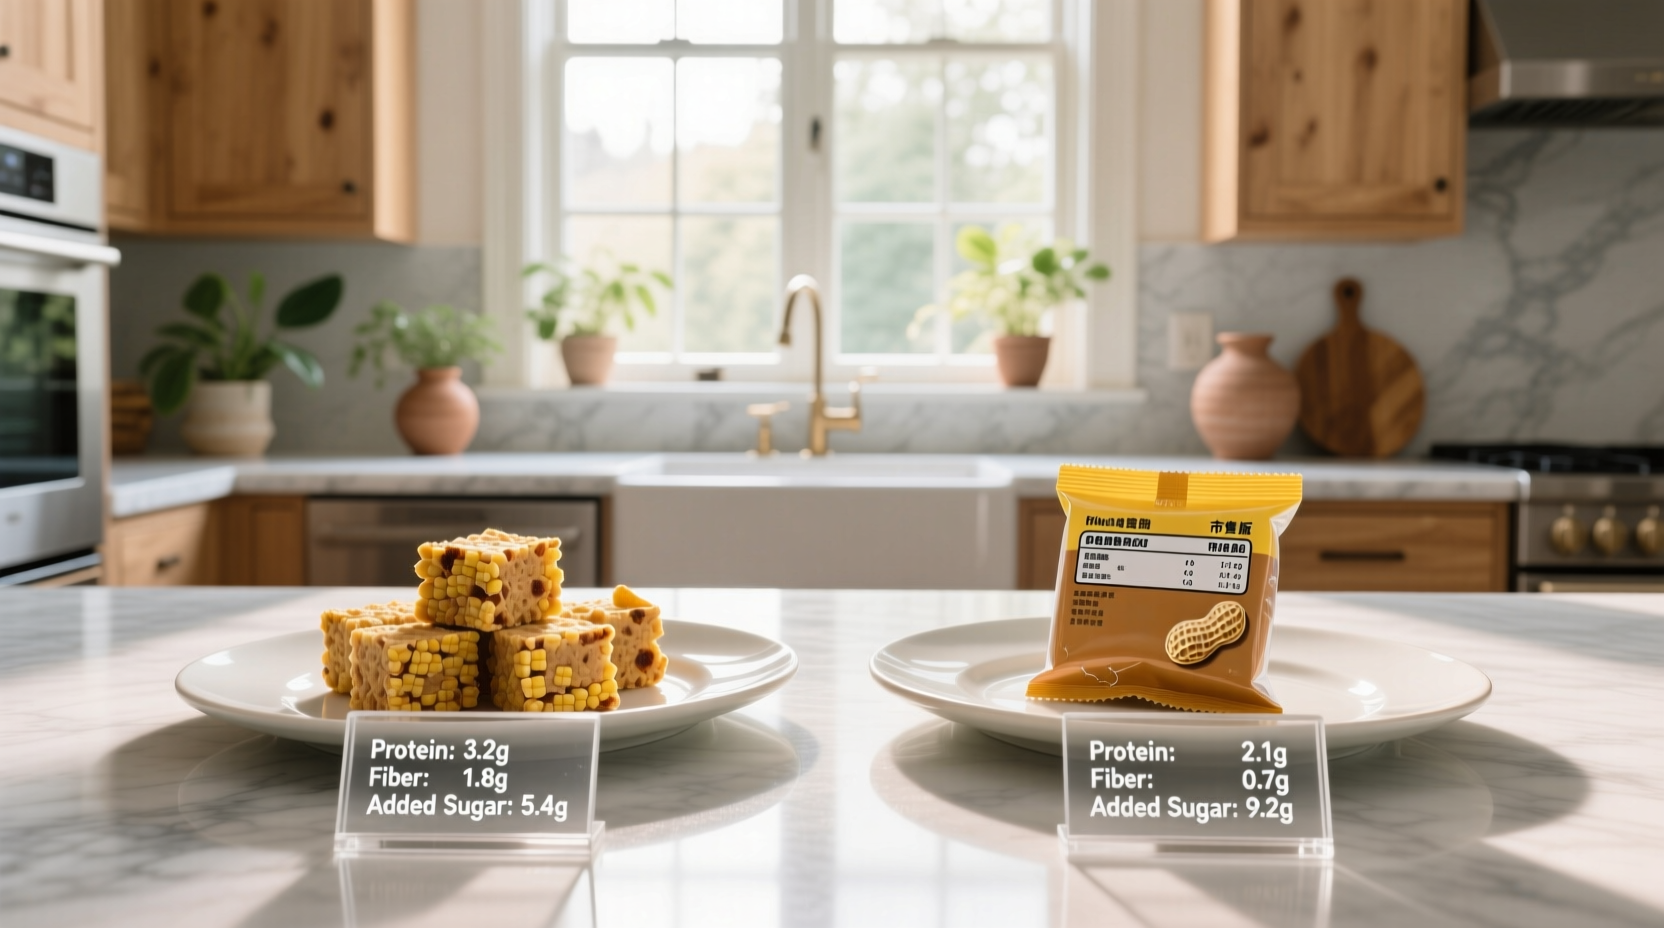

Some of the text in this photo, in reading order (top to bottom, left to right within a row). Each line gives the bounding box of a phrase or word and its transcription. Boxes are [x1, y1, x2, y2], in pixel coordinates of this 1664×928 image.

[371, 738, 509, 766] Protein: 3.2g
[1090, 740, 1287, 768] Protein: 2.1g
[369, 766, 508, 794] Fiber: 1.8g
[1091, 767, 1289, 796] Fiber: 0.7g
[366, 794, 568, 822] Added Sugar: 5.4g
[1090, 796, 1294, 825] Added Sugar: 9.2g
